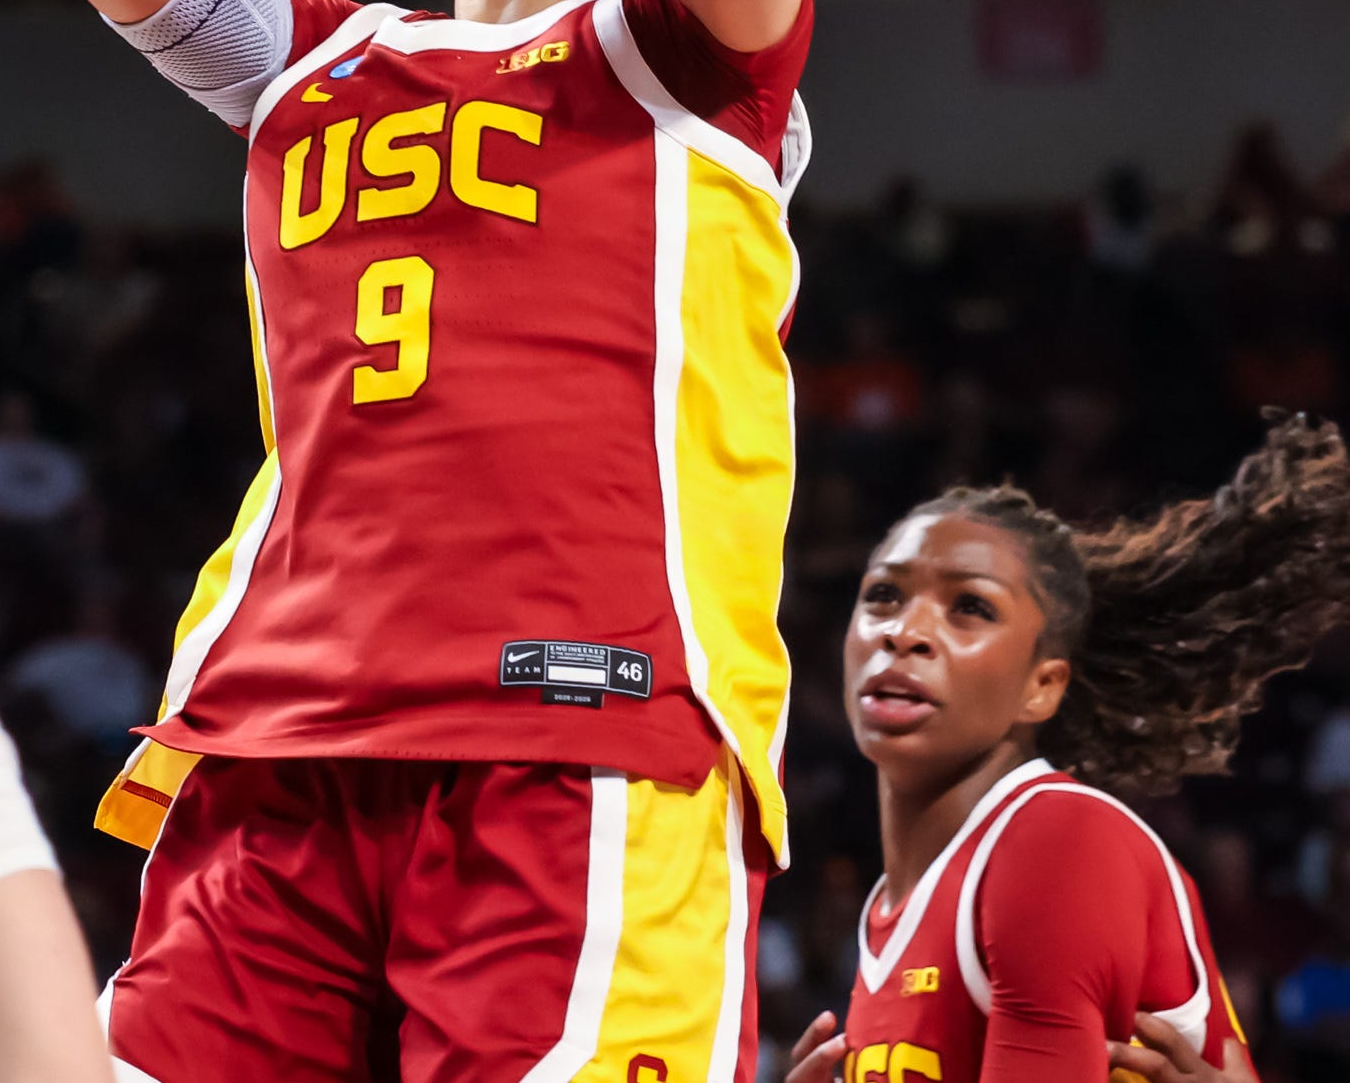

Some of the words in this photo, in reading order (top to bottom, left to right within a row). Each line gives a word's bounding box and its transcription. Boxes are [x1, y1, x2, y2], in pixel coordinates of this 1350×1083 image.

[279, 100, 544, 251] USC
[352, 255, 435, 405] 9
[506, 666, 541, 675] TEAM
[616, 661, 643, 683] 46
